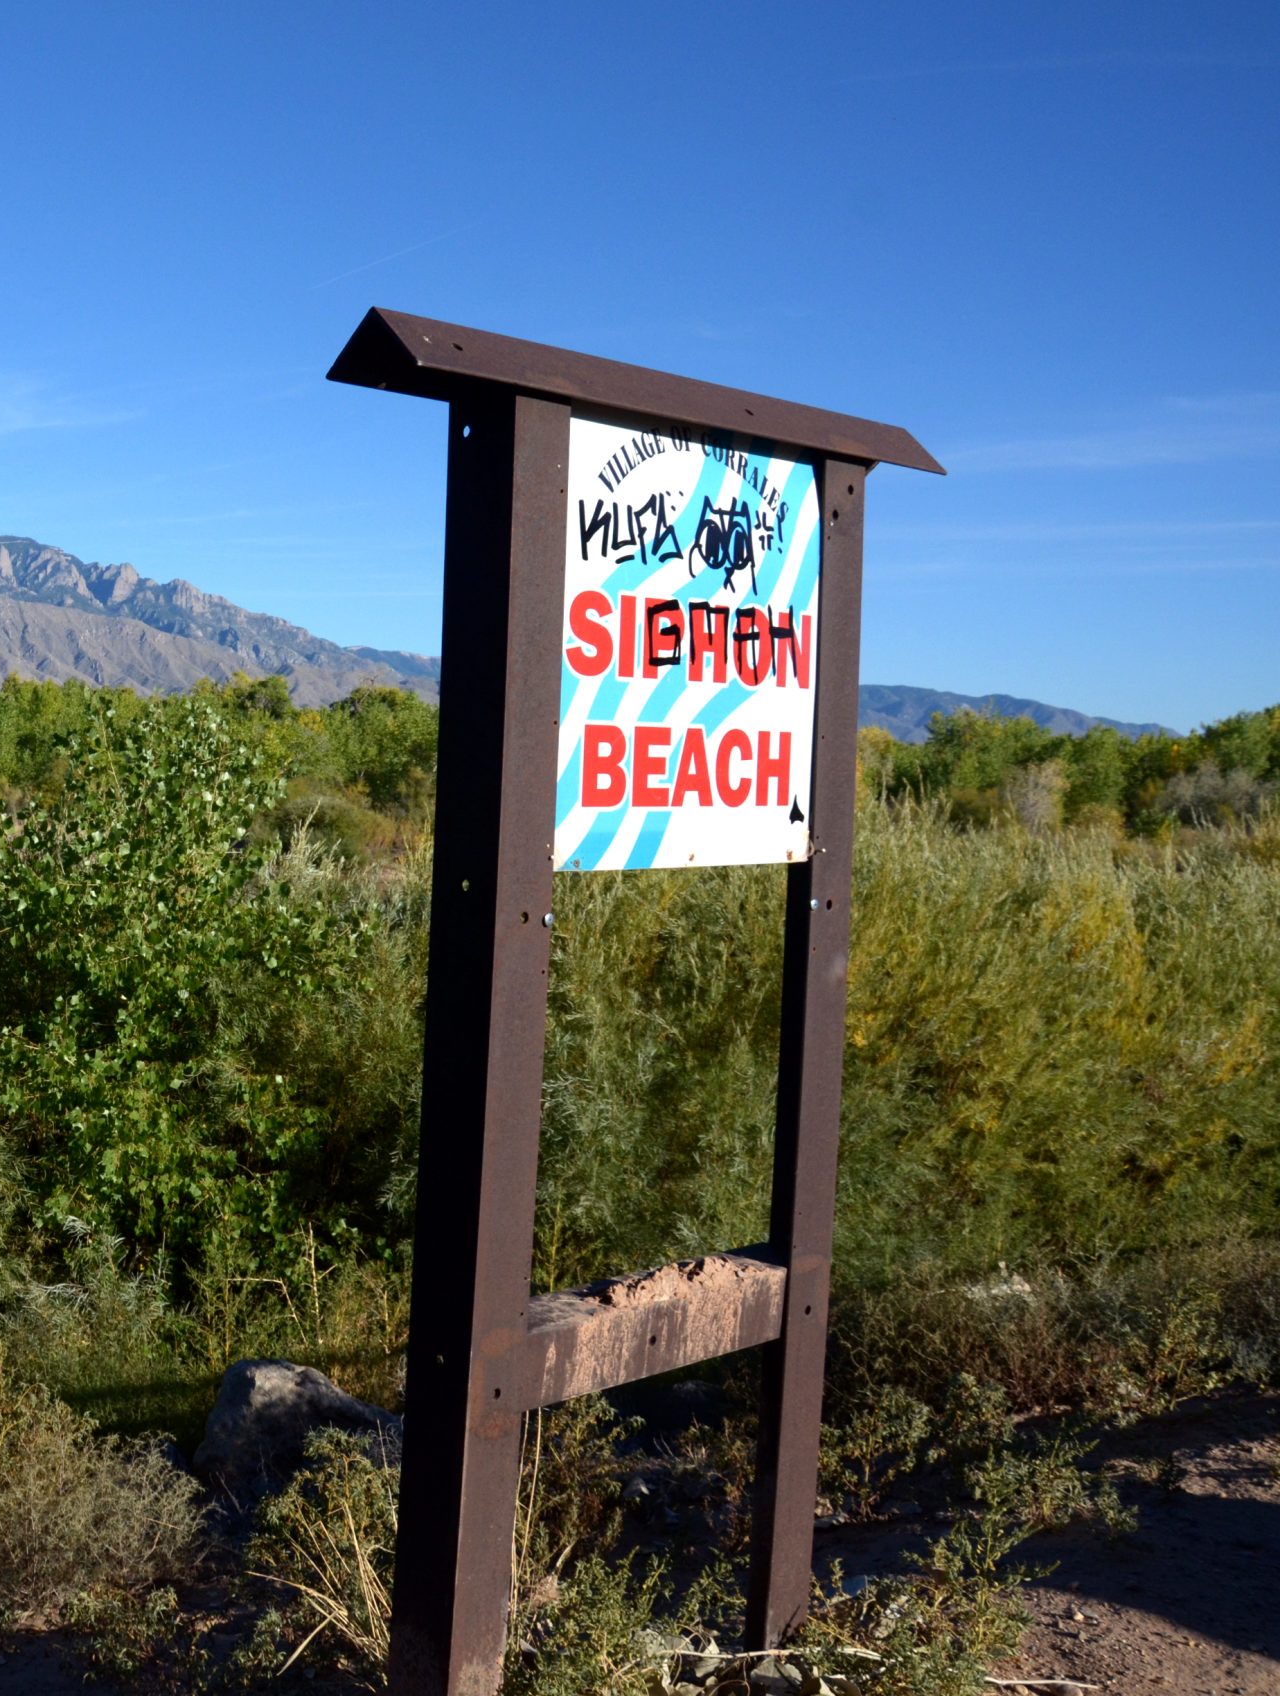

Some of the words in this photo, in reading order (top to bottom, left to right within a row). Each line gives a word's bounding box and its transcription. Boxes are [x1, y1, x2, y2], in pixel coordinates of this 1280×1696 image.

[598, 426, 666, 493] VILLAGE
[670, 425, 693, 452] OF
[701, 431, 789, 523] CORRALES
[565, 590, 811, 689] SIPHON
[581, 725, 792, 808] BEACH
